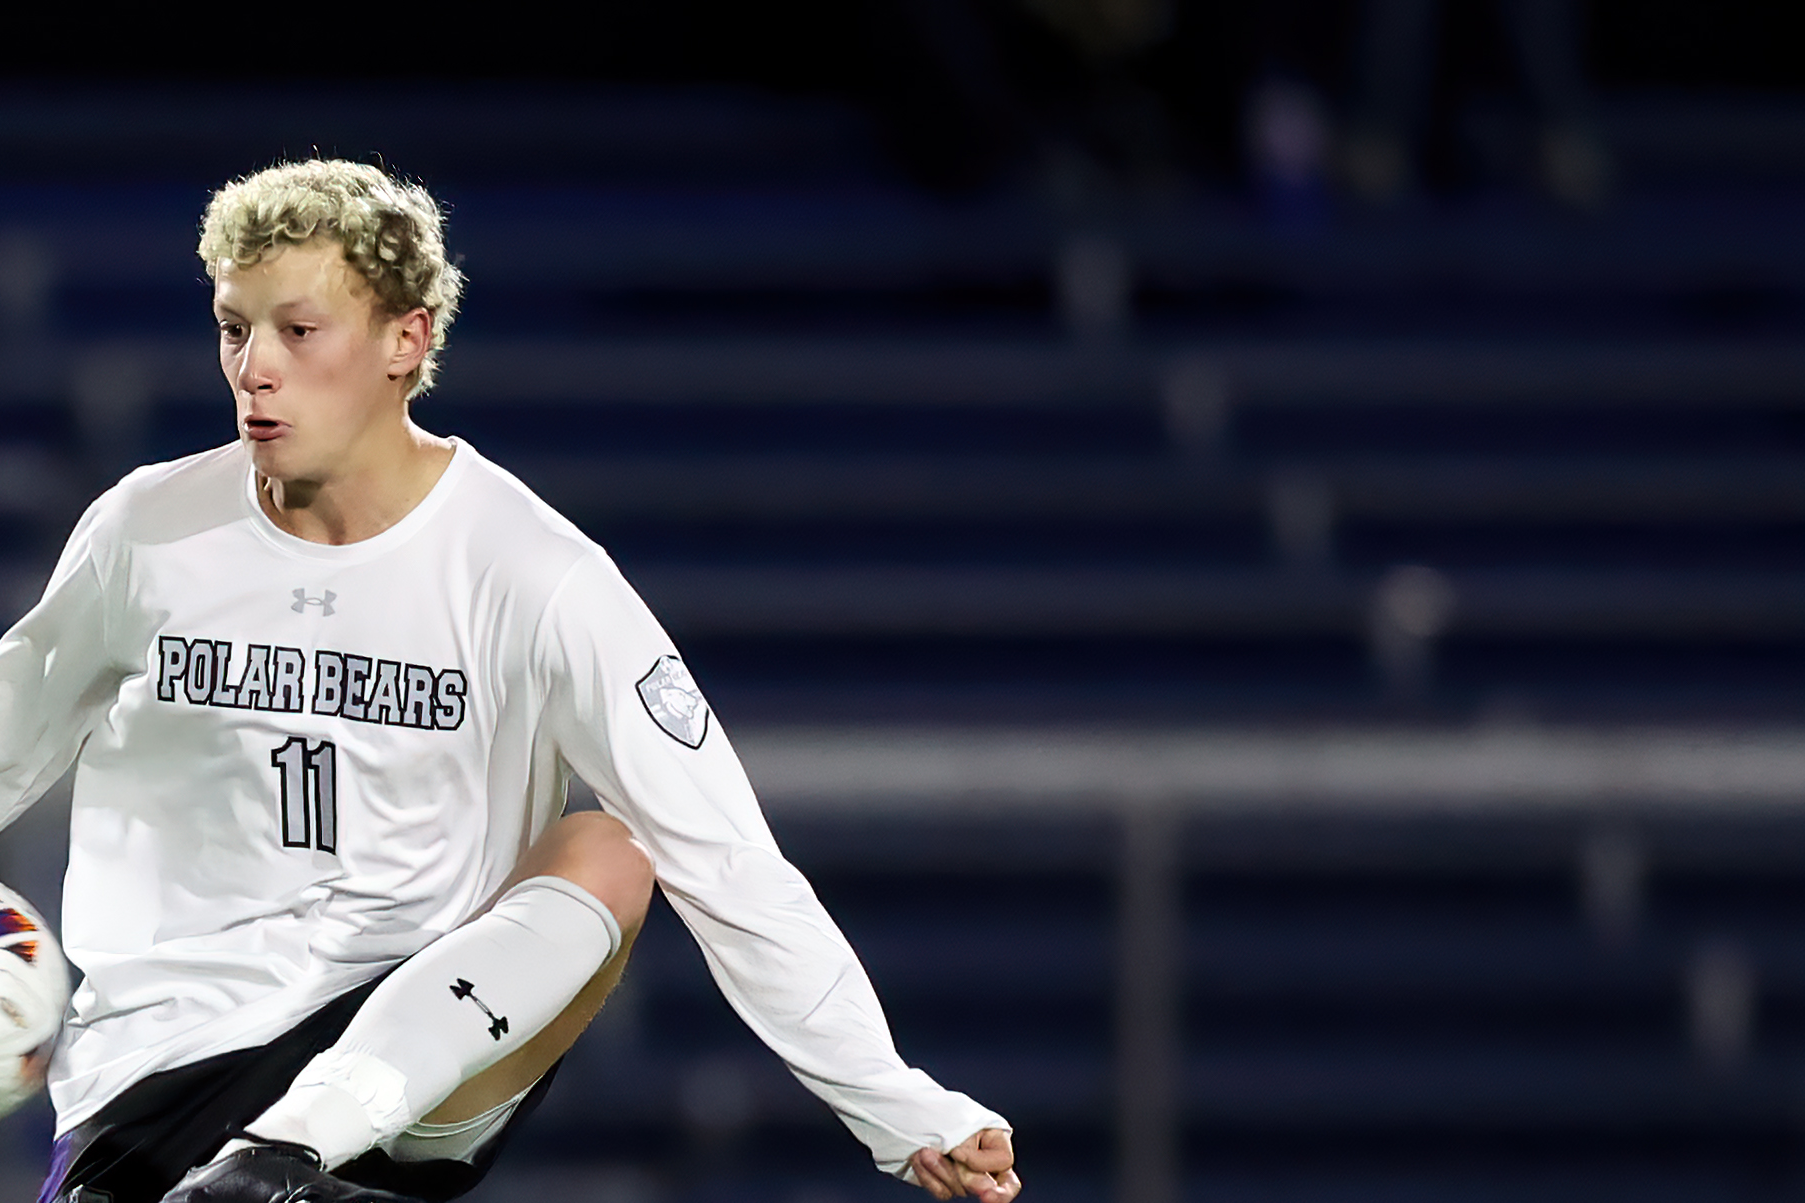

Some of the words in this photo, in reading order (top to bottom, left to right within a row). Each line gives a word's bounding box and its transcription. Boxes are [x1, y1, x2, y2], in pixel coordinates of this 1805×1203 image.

[157, 635, 306, 713] POLAR
[311, 650, 468, 730] BEARS
[271, 736, 337, 855] 11
